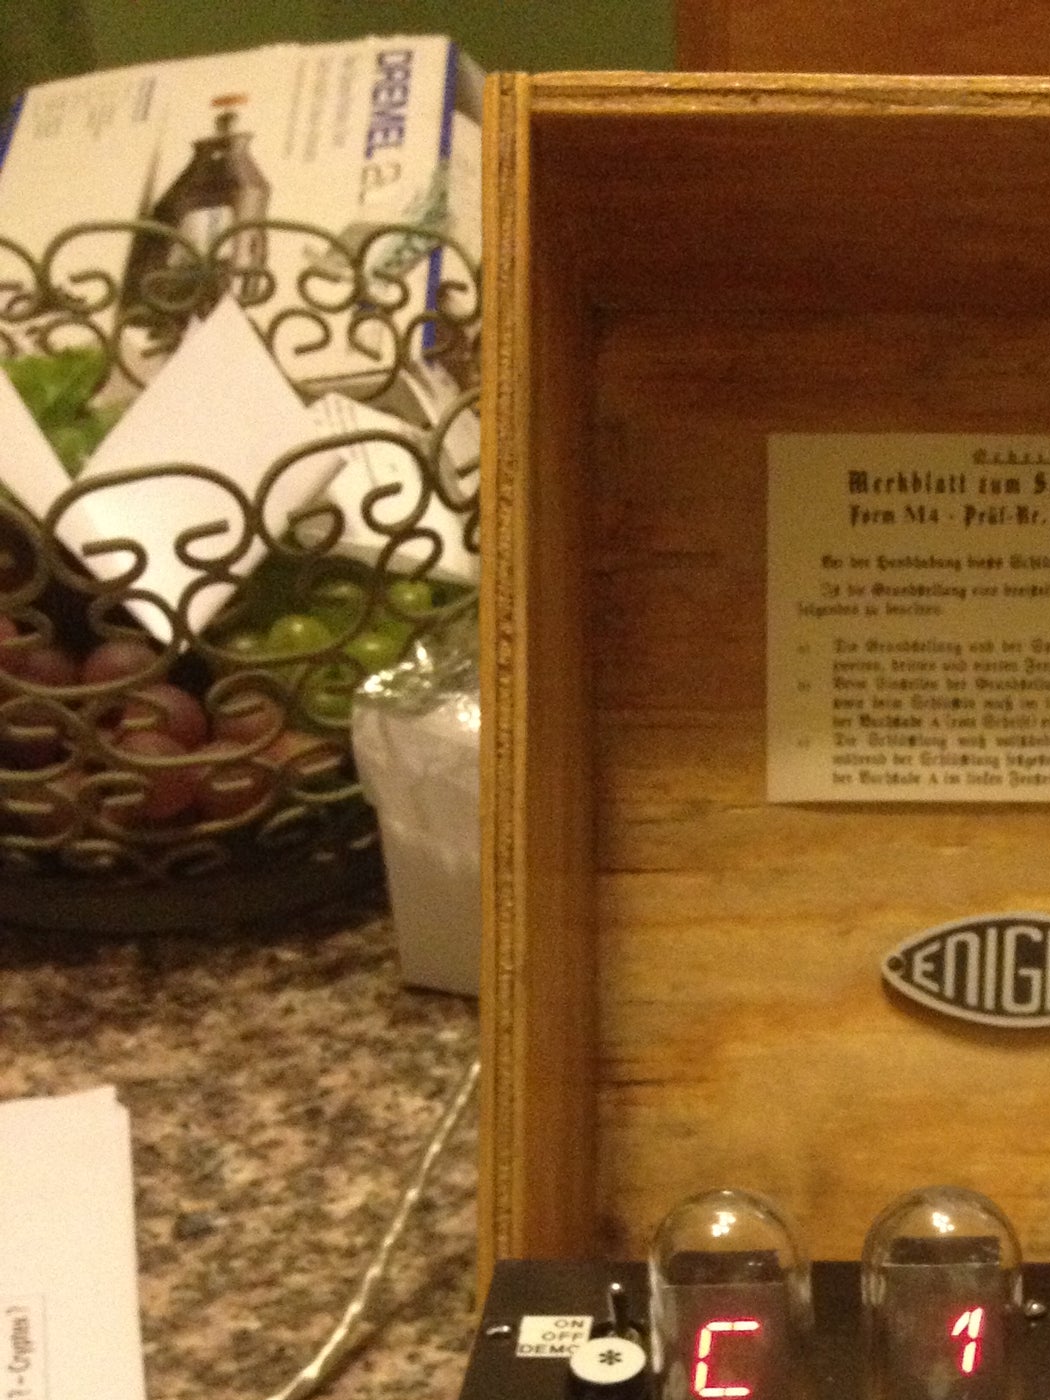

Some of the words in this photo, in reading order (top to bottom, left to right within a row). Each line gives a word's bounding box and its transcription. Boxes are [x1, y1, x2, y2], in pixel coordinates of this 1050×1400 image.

[554, 1320, 584, 1328] ON
[542, 1331, 582, 1341] OFF
[694, 1317, 760, 1398] C
[951, 1307, 984, 1374] 1
